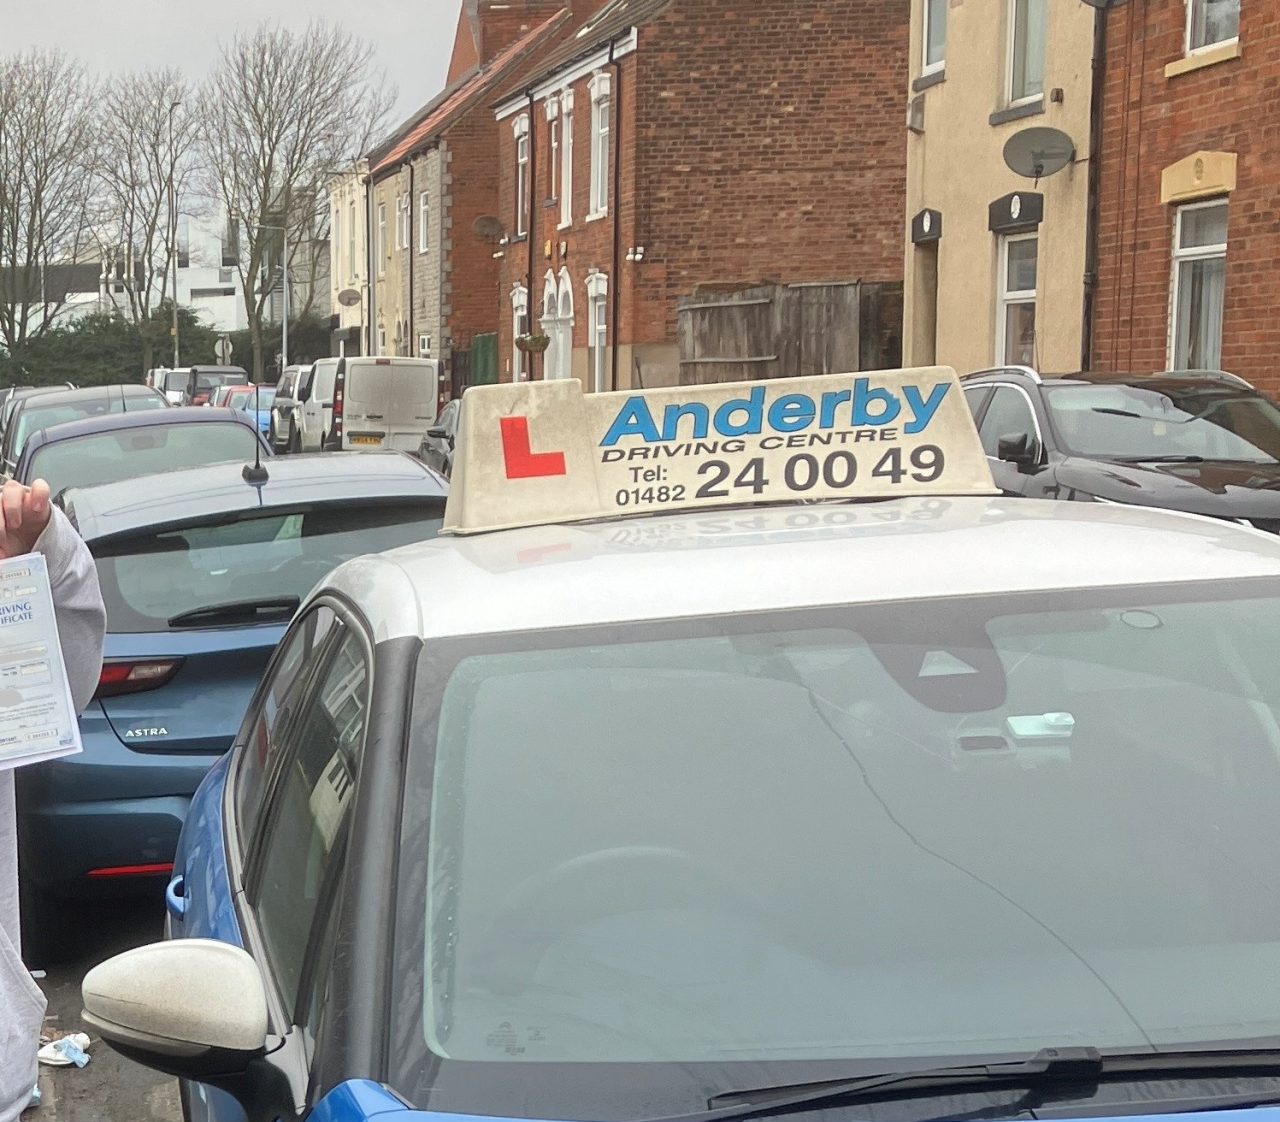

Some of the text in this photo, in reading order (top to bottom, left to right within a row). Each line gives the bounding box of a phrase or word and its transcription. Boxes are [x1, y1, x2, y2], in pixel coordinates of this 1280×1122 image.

[599, 377, 952, 447] Anderby
[499, 416, 567, 479] L
[600, 428, 898, 463] DRIVING CENTRE
[628, 465, 668, 484] Tel:
[695, 444, 945, 499] 24 00 49
[616, 484, 687, 507] 01482
[125, 727, 168, 737] ASTRA
